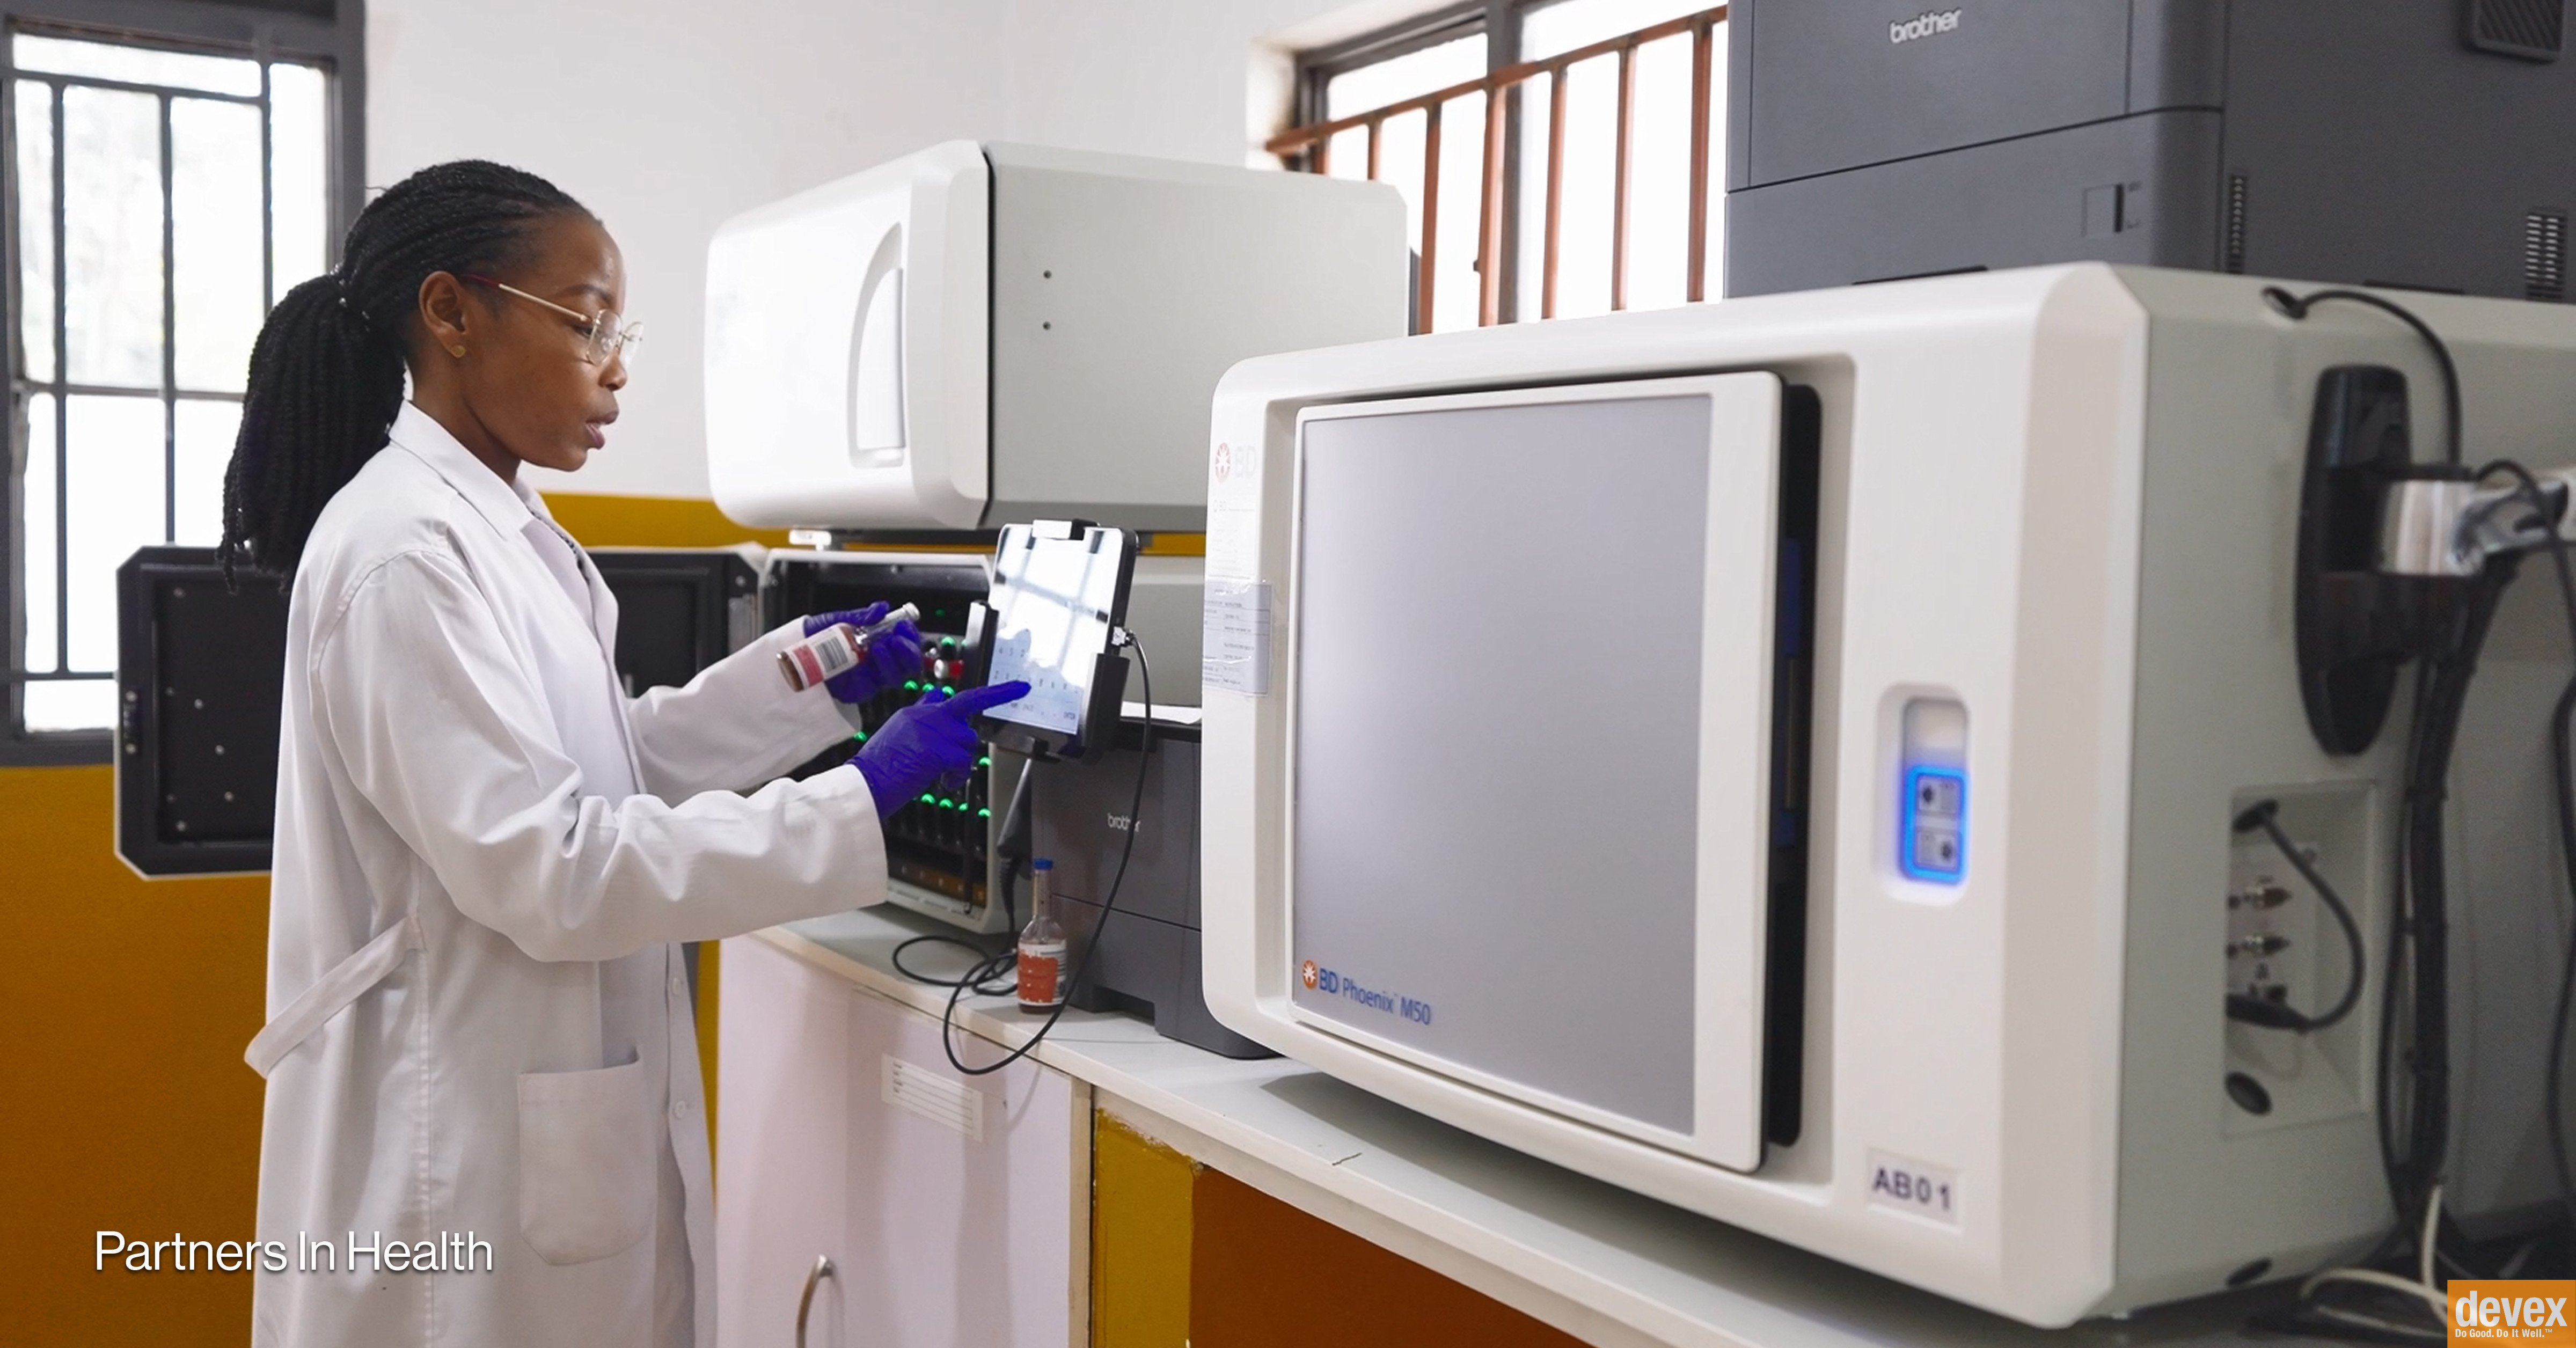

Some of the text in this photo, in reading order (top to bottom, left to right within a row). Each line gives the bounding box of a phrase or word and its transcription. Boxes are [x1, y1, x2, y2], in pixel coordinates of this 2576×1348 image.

[1890, 9, 1962, 43] brother
[1235, 445, 1256, 478] BD
[1319, 968, 1338, 993] BD
[1400, 996, 1432, 1025] M50
[1872, 1168, 1950, 1211] AB01
